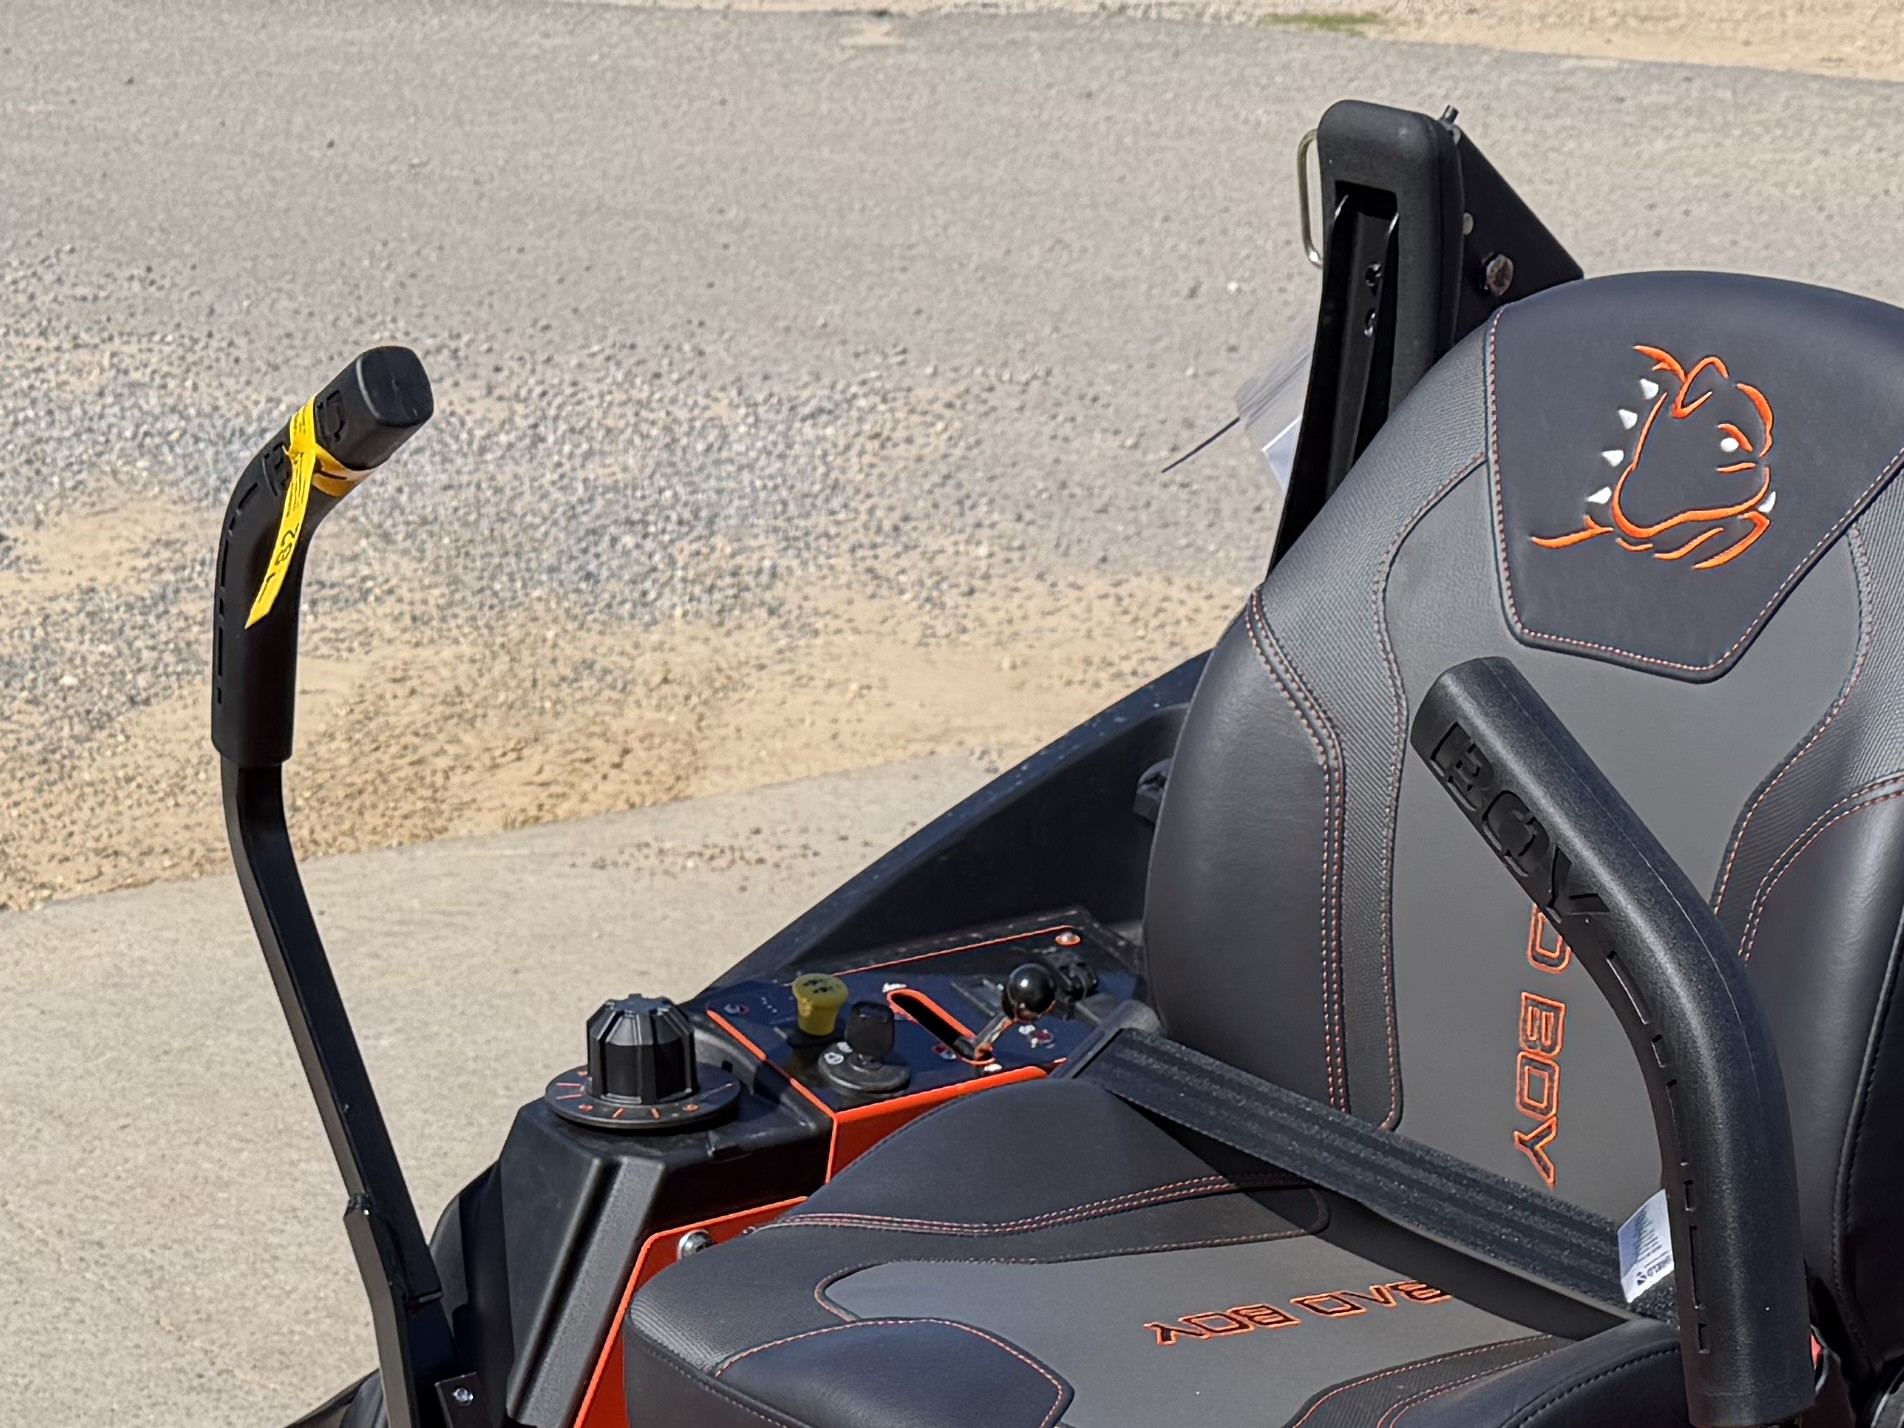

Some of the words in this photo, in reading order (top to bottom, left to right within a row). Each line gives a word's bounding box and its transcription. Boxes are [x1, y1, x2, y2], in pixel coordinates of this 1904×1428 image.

[1428, 720, 1612, 922] BOY
[1514, 990, 1567, 1189] BOY
[1144, 1304, 1301, 1346] BOY
[1291, 1280, 1453, 1318] BAD
